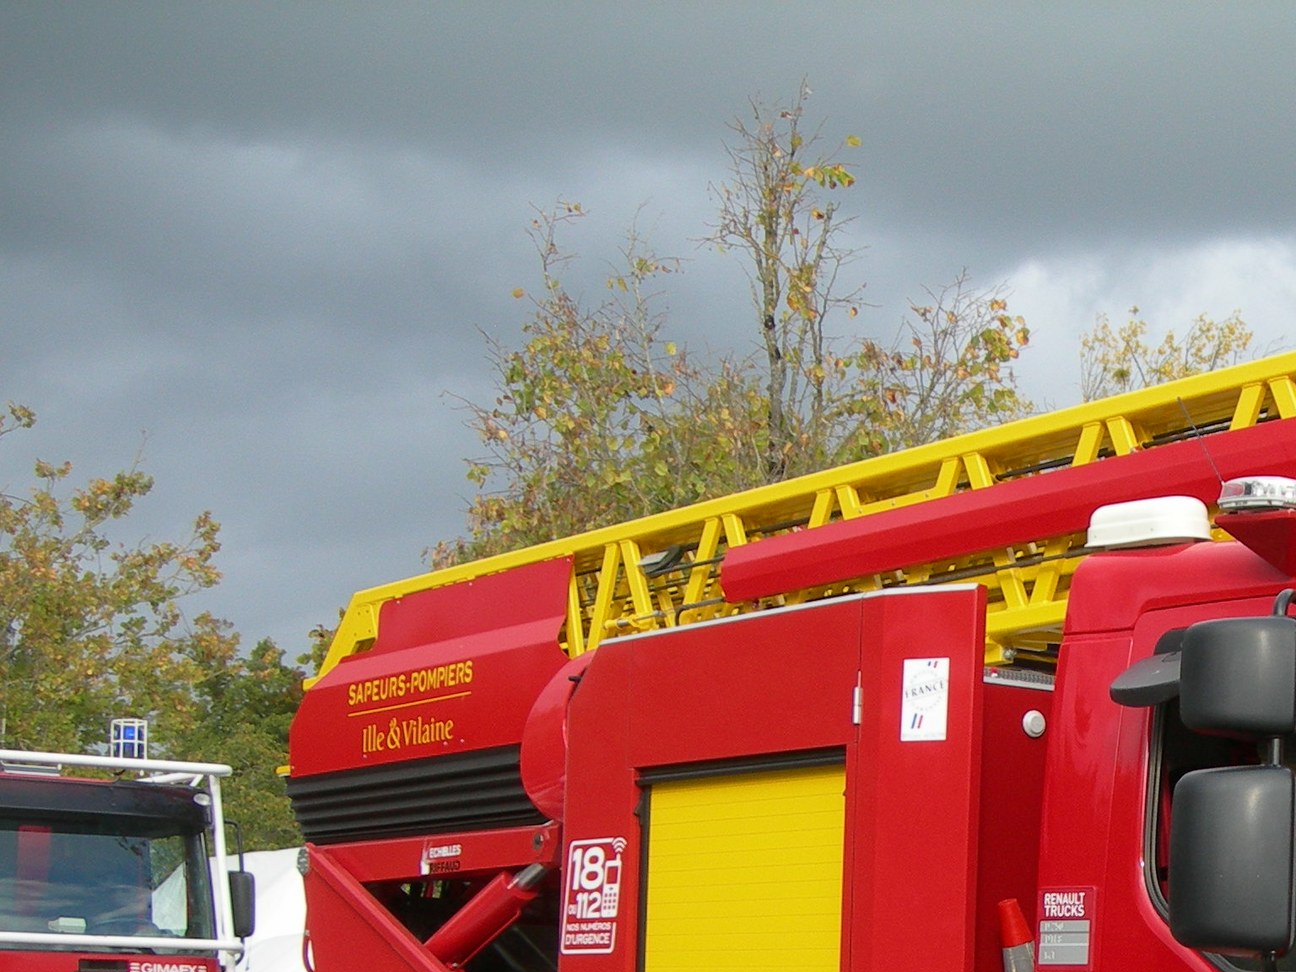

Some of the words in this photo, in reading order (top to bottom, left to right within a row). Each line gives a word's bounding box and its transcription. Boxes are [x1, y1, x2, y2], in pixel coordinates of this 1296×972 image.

[362, 724, 385, 753] Ille
[401, 716, 454, 746] Vilaine
[572, 846, 605, 891] 18
[576, 891, 602, 919] 112
[1044, 892, 1086, 905] RENAULT
[1044, 904, 1085, 918] TRUCKS
[565, 932, 611, 945] D'URGENCE
